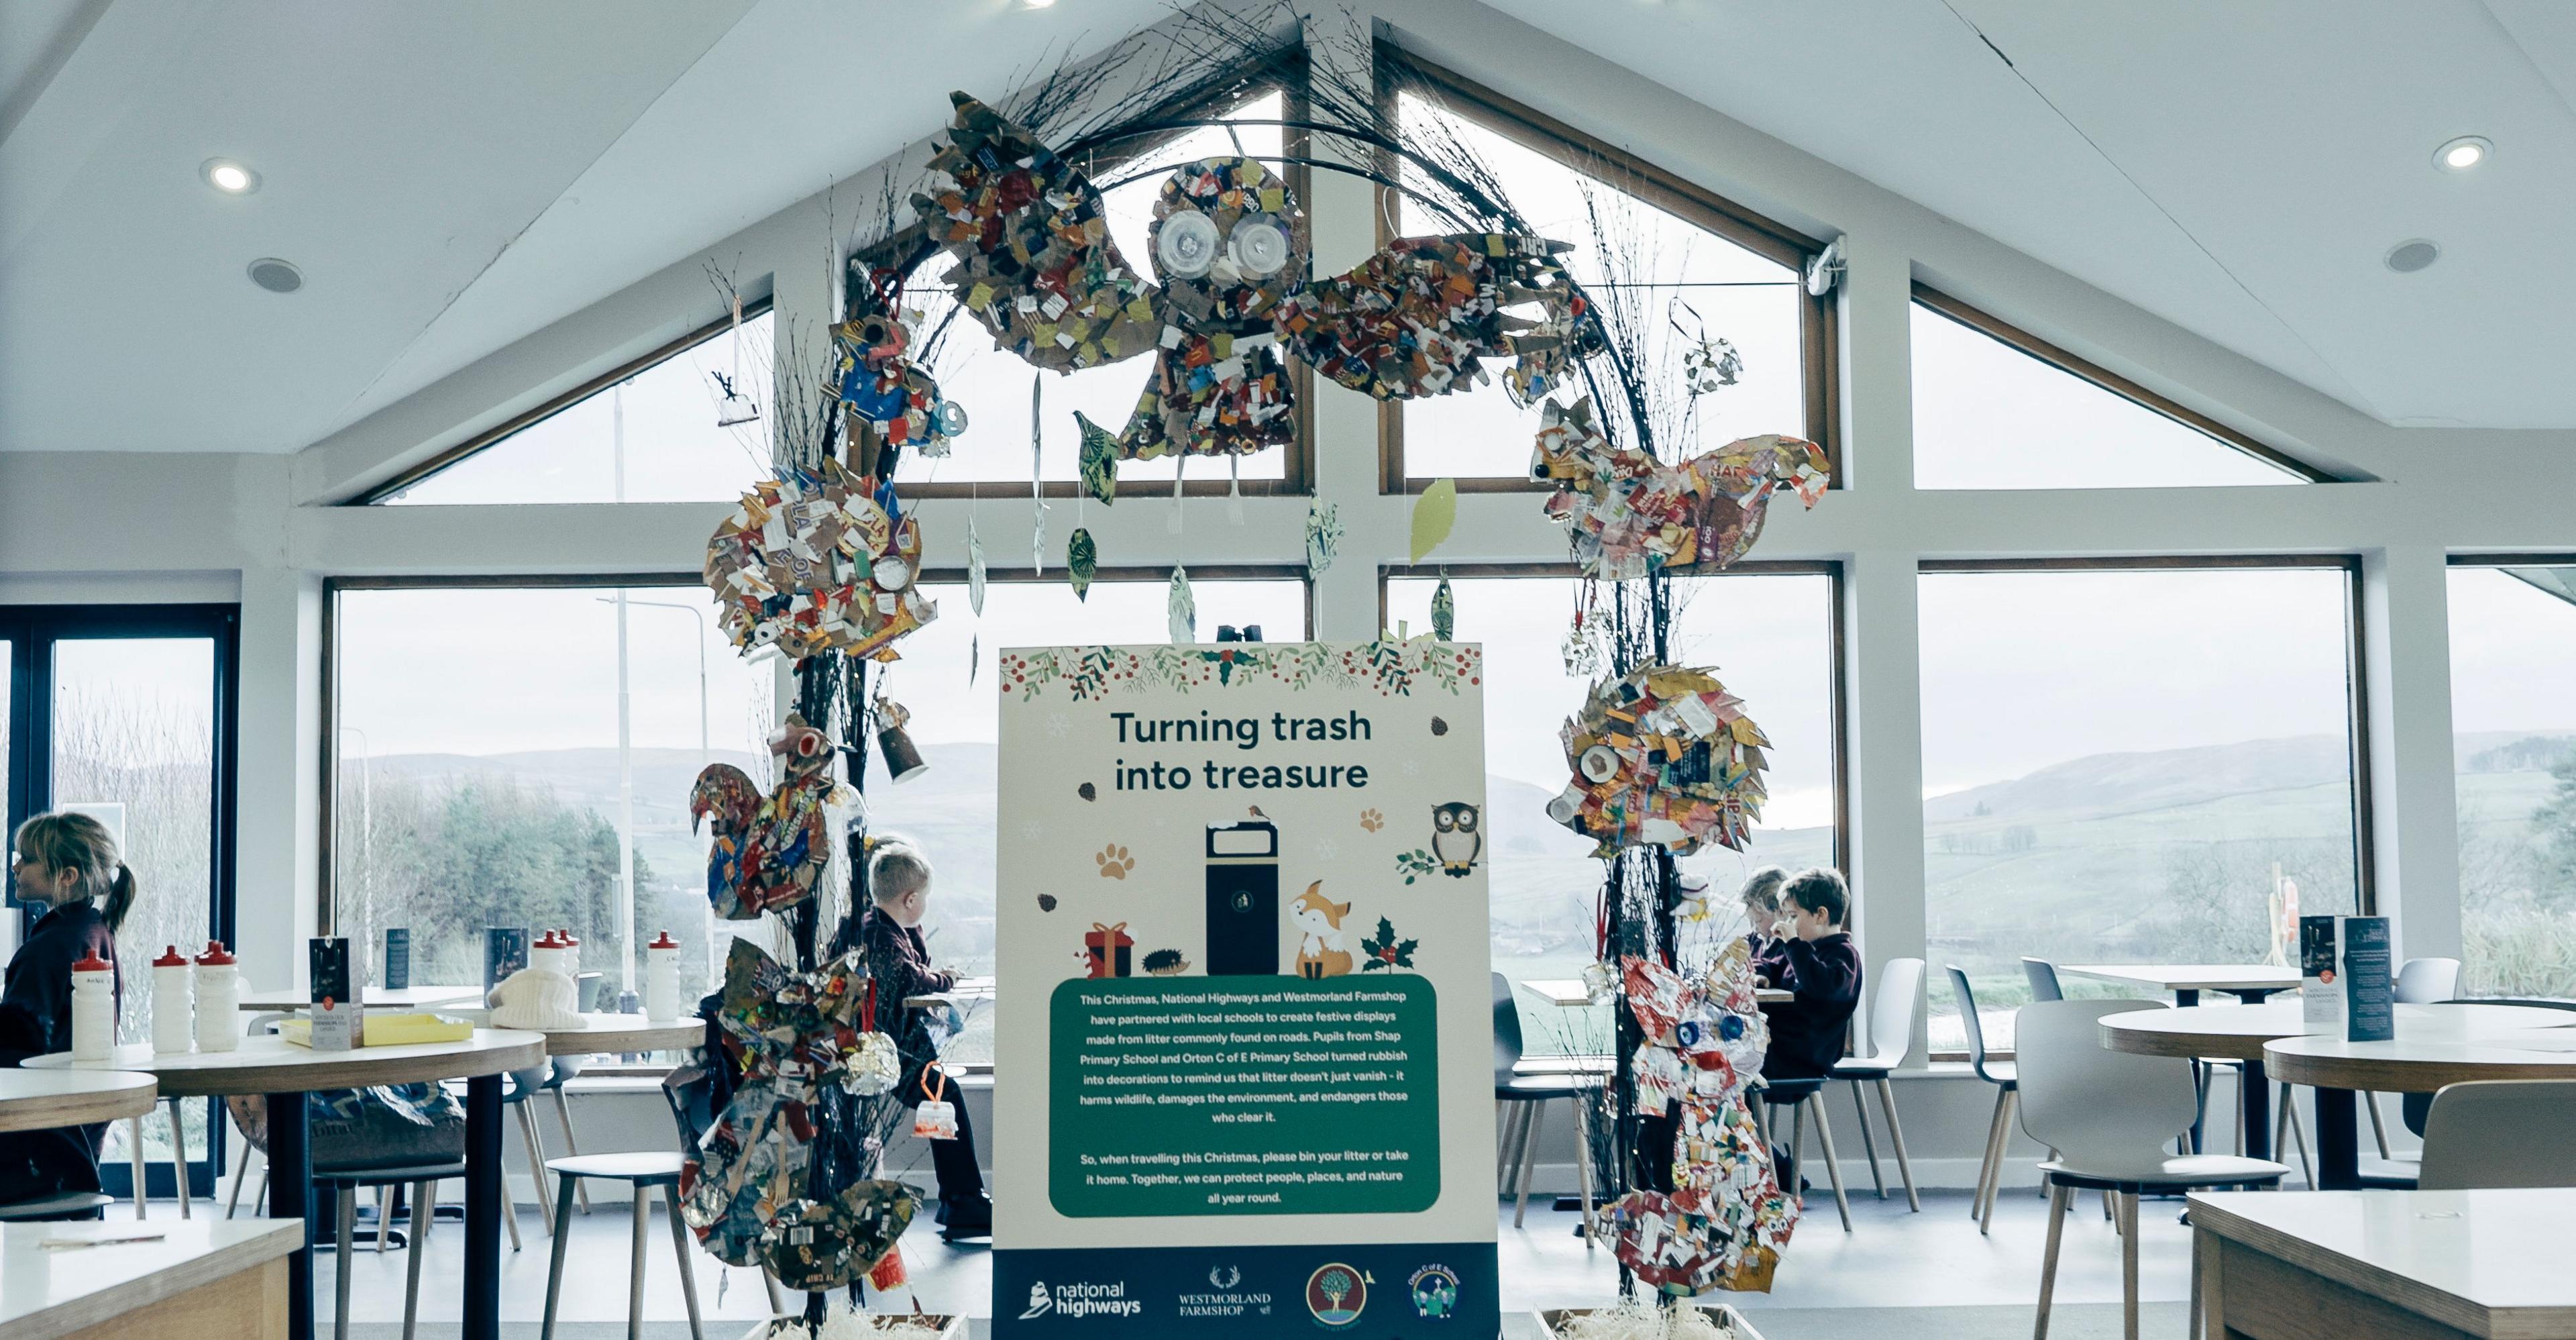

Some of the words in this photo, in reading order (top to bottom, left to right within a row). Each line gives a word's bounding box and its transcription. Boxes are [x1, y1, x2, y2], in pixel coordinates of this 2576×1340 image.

[1110, 710, 1258, 750] Turning
[1271, 710, 1371, 741] trash
[1116, 758, 1191, 790] into
[1203, 760, 1368, 789] treasure
[1080, 995, 1102, 1005] This
[1104, 994, 1159, 1005] Christmas,
[1161, 993, 1206, 1004] National
[1208, 993, 1260, 1005] Highways
[1261, 992, 1281, 1002] and
[1283, 991, 1353, 1002] Westmorland
[1354, 991, 1407, 1003] Farmshop
[1090, 1015, 1116, 1025] have
[1118, 1014, 1170, 1027] partnered
[1171, 1013, 1195, 1023] with
[1197, 1013, 1222, 1023] local
[1224, 1013, 1265, 1023] schools
[1266, 1013, 1278, 1023] to
[1279, 1013, 1313, 1023] create
[1316, 1011, 1352, 1022] festive
[1353, 1011, 1396, 1023] displays
[1086, 1035, 1116, 1045] made
[1118, 1034, 1143, 1044] from
[1145, 1034, 1171, 1044] litter
[1173, 1033, 1228, 1045] commonly
[1230, 1032, 1261, 1043] found
[1263, 1034, 1277, 1042] on
[1279, 1031, 1311, 1042] roads.
[1313, 1031, 1344, 1043] Pupils
[1346, 1031, 1373, 1041] from
[1375, 1031, 1401, 1043] Shap
[1080, 1055, 1120, 1066] Primary
[1122, 1054, 1159, 1064] School
[1161, 1053, 1181, 1064] and
[1182, 1053, 1214, 1064] Orton
[1216, 1052, 1224, 1063] C
[1226, 1052, 1238, 1063] of
[1240, 1052, 1247, 1063] E
[1250, 1052, 1291, 1064] Primary
[1293, 1051, 1329, 1062] School
[1330, 1051, 1366, 1062] turned
[1368, 1051, 1407, 1061] rubbish
[1083, 1075, 1105, 1085] into
[1106, 1074, 1169, 1084] decorations
[1171, 1074, 1183, 1084] to
[1184, 1073, 1222, 1083] remind
[1223, 1074, 1236, 1083] us
[1238, 1072, 1260, 1083] that
[1262, 1072, 1288, 1082] litter
[1289, 1072, 1329, 1082] doesn't
[1330, 1071, 1351, 1084] just
[1353, 1071, 1387, 1081] vanish
[1396, 1070, 1404, 1081] it
[1080, 1095, 1112, 1105] harms
[1114, 1094, 1155, 1104] wildlife,
[1157, 1094, 1205, 1106] damages
[1207, 1093, 1226, 1103] the
[1227, 1092, 1297, 1103] environment,
[1299, 1092, 1319, 1102] and
[1320, 1091, 1377, 1104] endangers
[1378, 1091, 1408, 1101] those
[1212, 1113, 1236, 1123] who
[1236, 1112, 1264, 1123] clear
[1265, 1112, 1276, 1122] it.
[1080, 1154, 1097, 1165] So,
[1099, 1154, 1129, 1164] when
[1130, 1153, 1180, 1166] travelling
[1182, 1153, 1202, 1164] this
[1203, 1152, 1260, 1163] Christmas,
[1263, 1151, 1297, 1164] please
[1299, 1151, 1316, 1162] bin
[1318, 1153, 1342, 1164] your
[1344, 1150, 1370, 1161] litter
[1371, 1152, 1383, 1161] or
[1385, 1150, 1409, 1161] take
[1086, 1175, 1094, 1185] it
[1096, 1175, 1128, 1185] home.
[1131, 1174, 1181, 1186] Together,
[1183, 1175, 1200, 1184] we
[1201, 1175, 1222, 1183] can
[1224, 1172, 1263, 1184] protect
[1266, 1172, 1305, 1184] people,
[1307, 1172, 1344, 1184] places,
[1346, 1171, 1366, 1182] and
[1368, 1171, 1403, 1181] nature
[1208, 1193, 1220, 1203] all
[1222, 1194, 1246, 1206] year
[1247, 1192, 1281, 1203] round.
[1057, 1281, 1124, 1298] national
[1179, 1294, 1271, 1304] WESTMORLAND
[1057, 1298, 1141, 1317] highways
[1180, 1306, 1244, 1316] FARMSHOP
